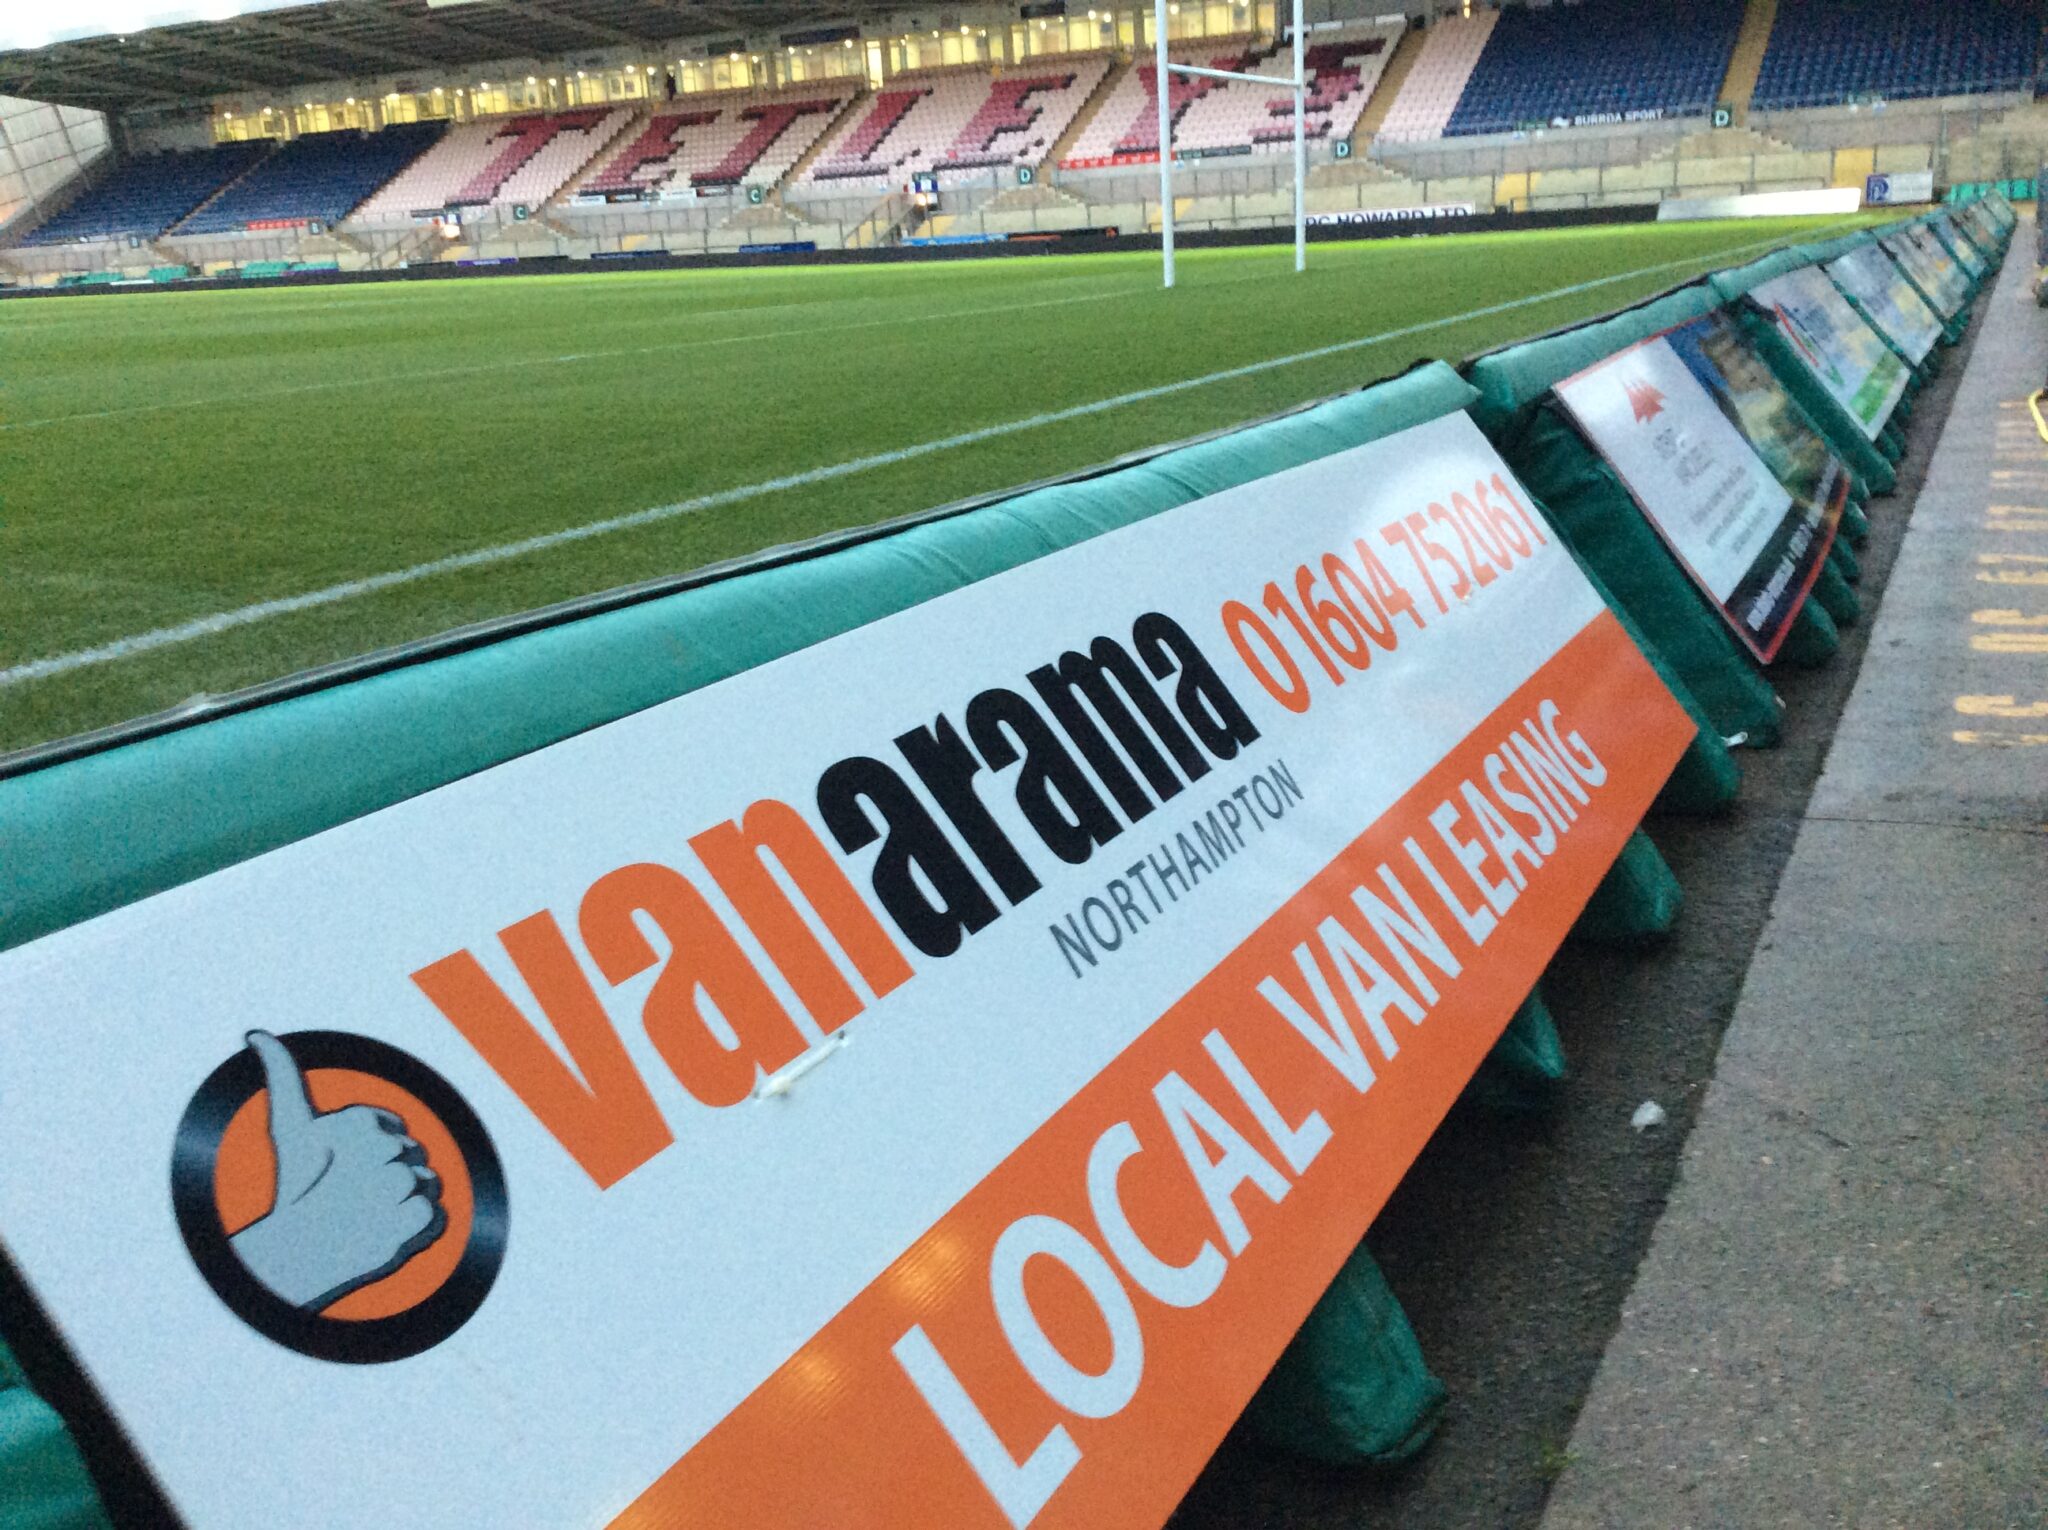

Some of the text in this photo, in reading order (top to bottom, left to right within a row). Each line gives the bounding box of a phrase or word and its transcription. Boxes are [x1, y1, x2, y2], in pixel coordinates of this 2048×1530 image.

[1336, 141, 1349, 158] D
[1625, 108, 1664, 122] SPORT
[1020, 168, 1031, 183] D
[410, 611, 1261, 1191] vanarama
[1220, 537, 1427, 714] 01604
[1379, 472, 1548, 615] 752061
[1048, 757, 1305, 979] NORTHAMPTON
[891, 698, 1608, 1530] LOCAL VAN LEASING
